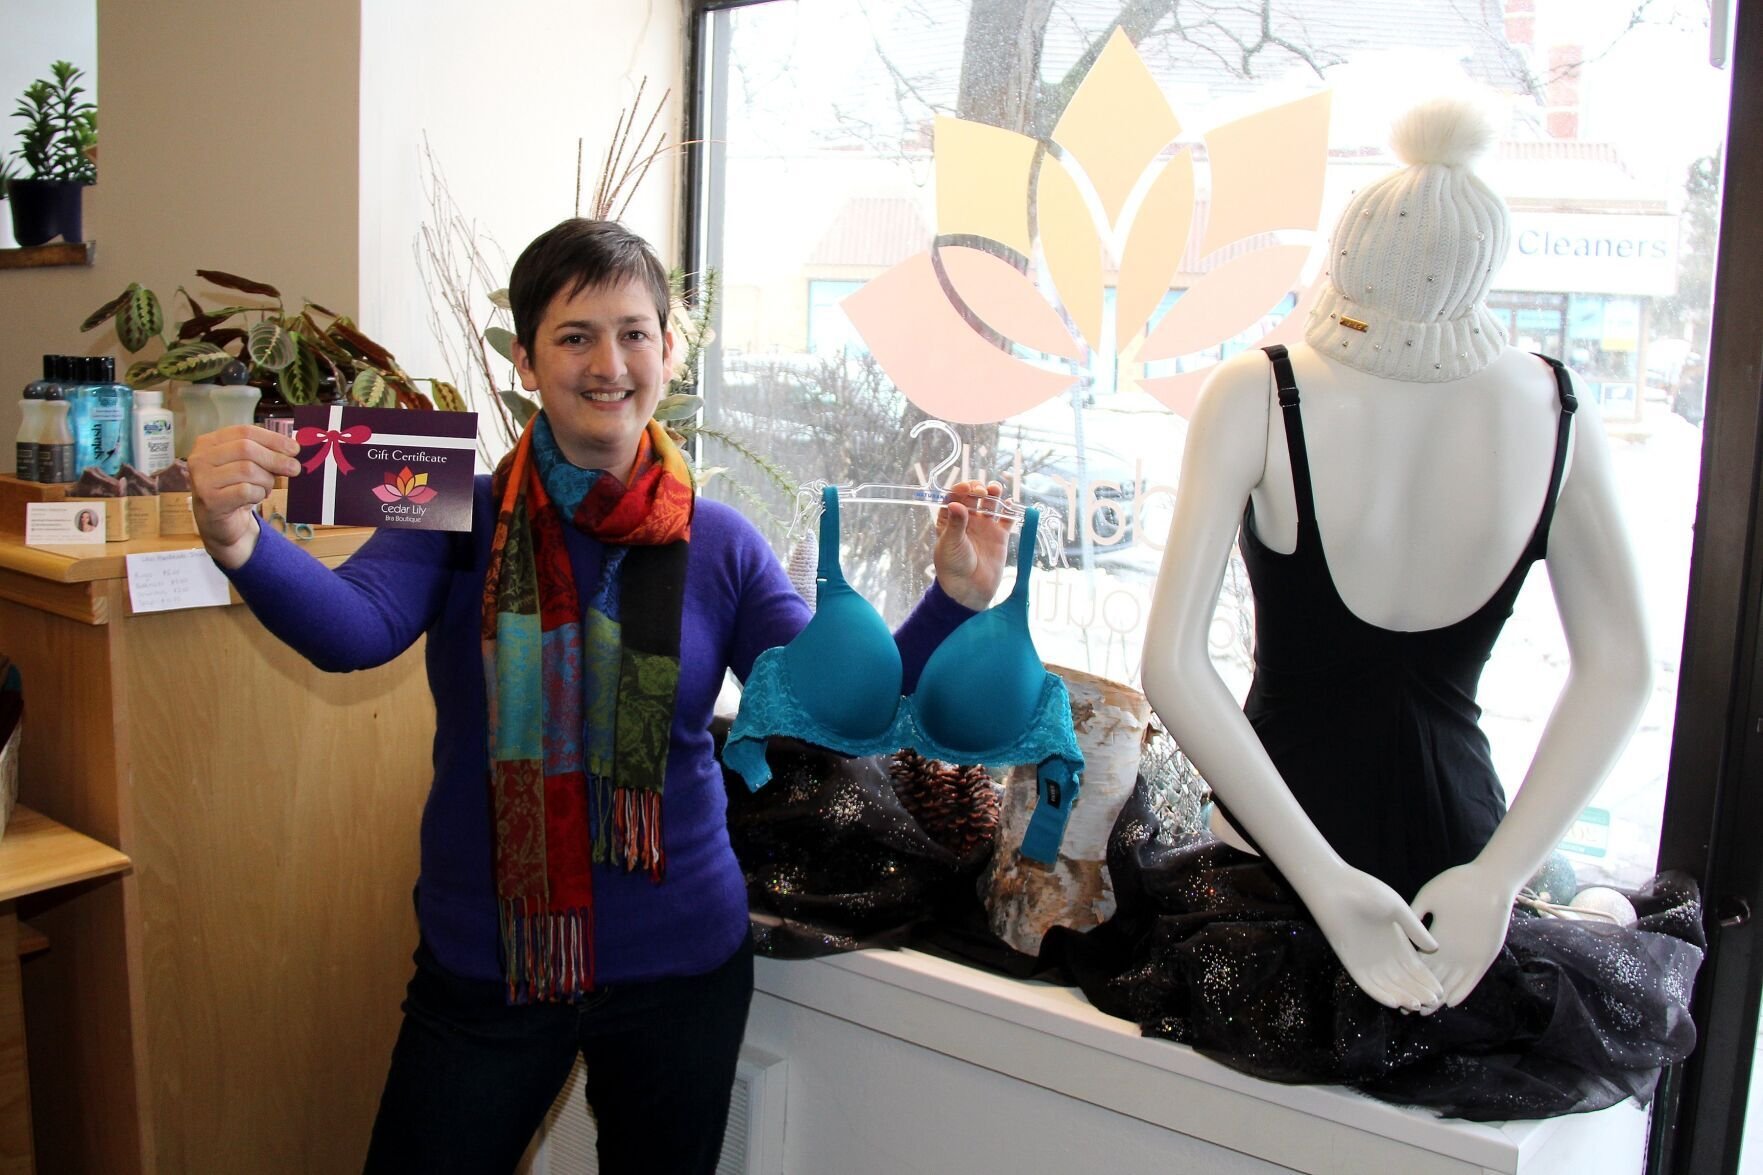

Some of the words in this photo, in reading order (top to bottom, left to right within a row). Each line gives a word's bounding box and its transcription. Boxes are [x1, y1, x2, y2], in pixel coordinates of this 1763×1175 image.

[1518, 229, 1667, 258] Cleaners
[367, 448, 389, 460] Gift
[392, 450, 447, 463] Certificate
[381, 503, 410, 514] Cedar
[412, 504, 427, 516] Lily
[395, 515, 421, 523] Boutique
